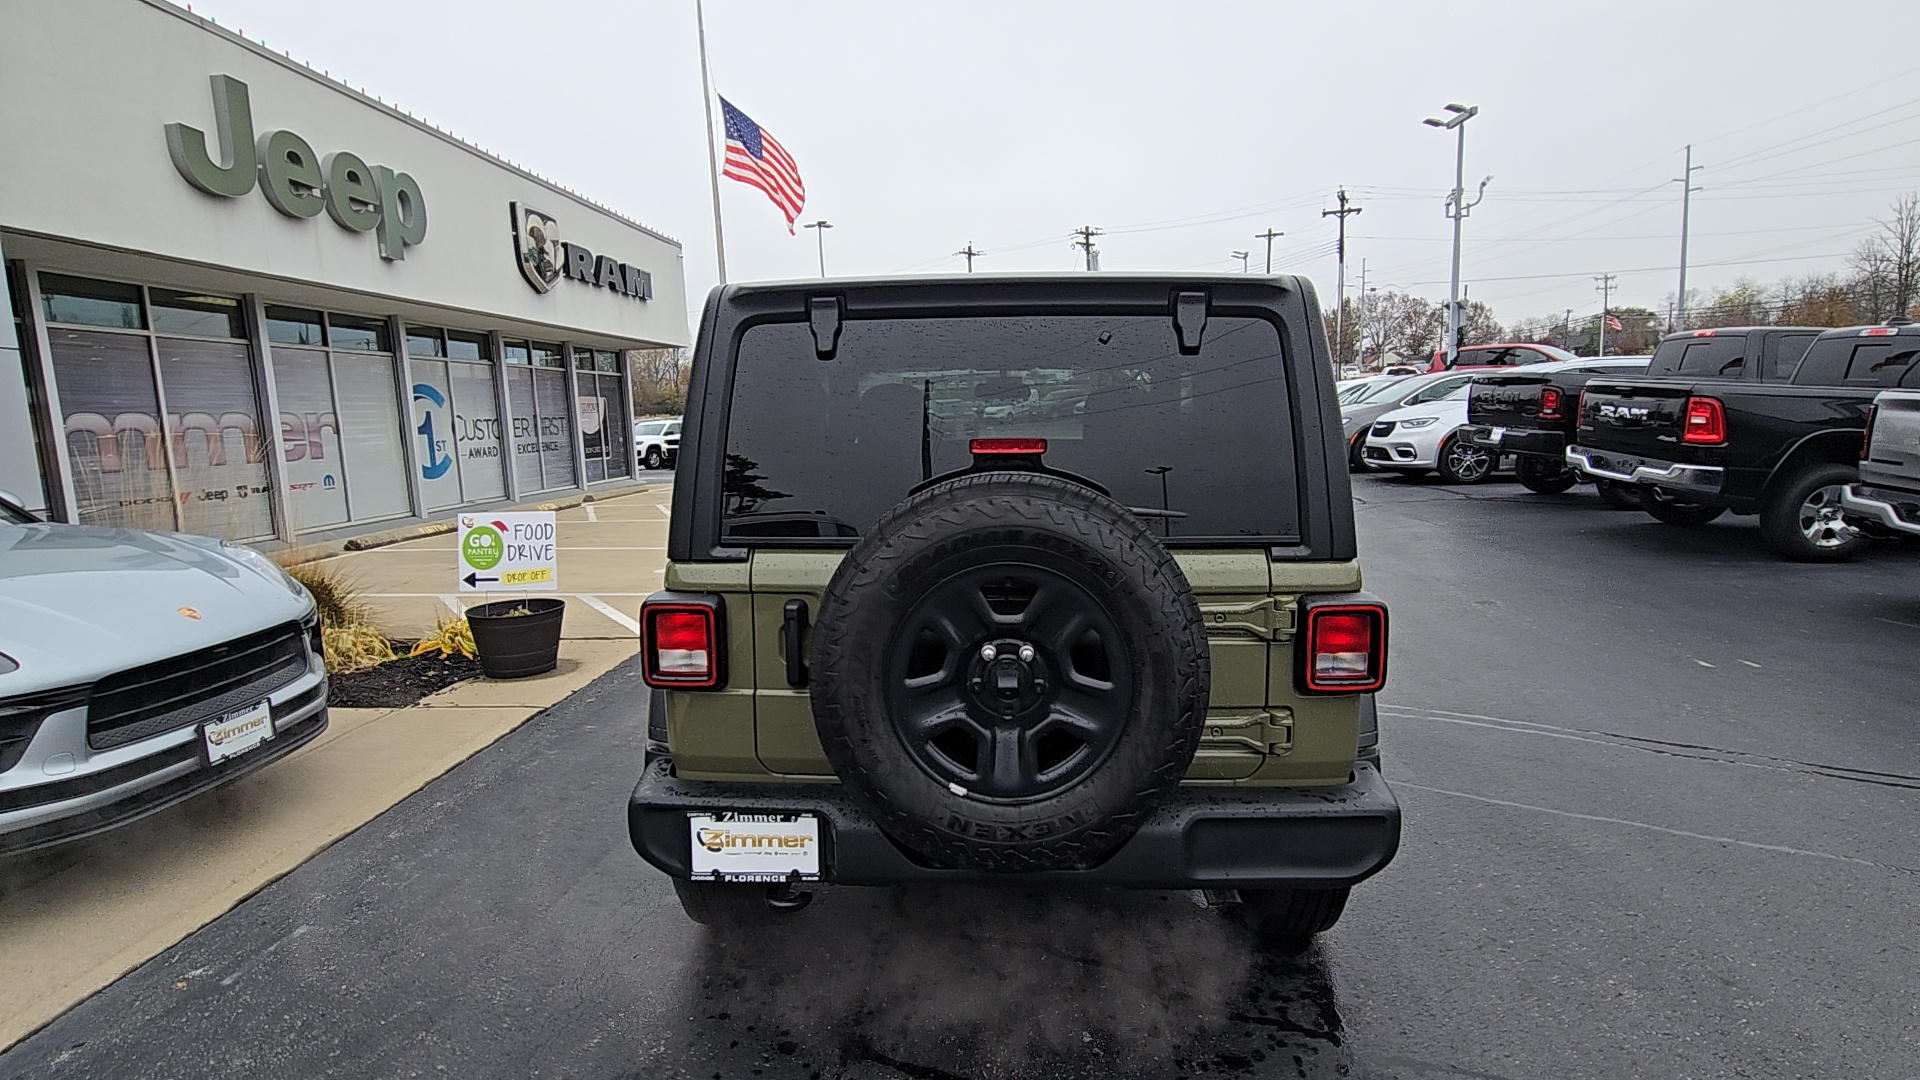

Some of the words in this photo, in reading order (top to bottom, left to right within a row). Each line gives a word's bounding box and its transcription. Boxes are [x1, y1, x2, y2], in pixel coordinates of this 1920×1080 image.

[165, 74, 427, 261] Jeep
[560, 242, 653, 300] RAM
[1600, 405, 1649, 420] RAM
[456, 414, 531, 442] CUSTOER
[468, 446, 498, 459] AWARD
[517, 442, 560, 455] EXCELENCE
[198, 489, 228, 501] Jeep
[469, 534, 495, 547] GO!
[514, 523, 554, 541] FOOD
[507, 544, 554, 562] DRIVE
[506, 573, 527, 583] DROP
[531, 570, 547, 580] OFF
[223, 706, 254, 722] Zimmer
[210, 715, 267, 744] Zimmer
[722, 811, 785, 823] Zimmer
[944, 807, 1084, 841] NEXEN
[703, 829, 814, 849] Zimmer
[724, 874, 788, 883] FLORENCE
